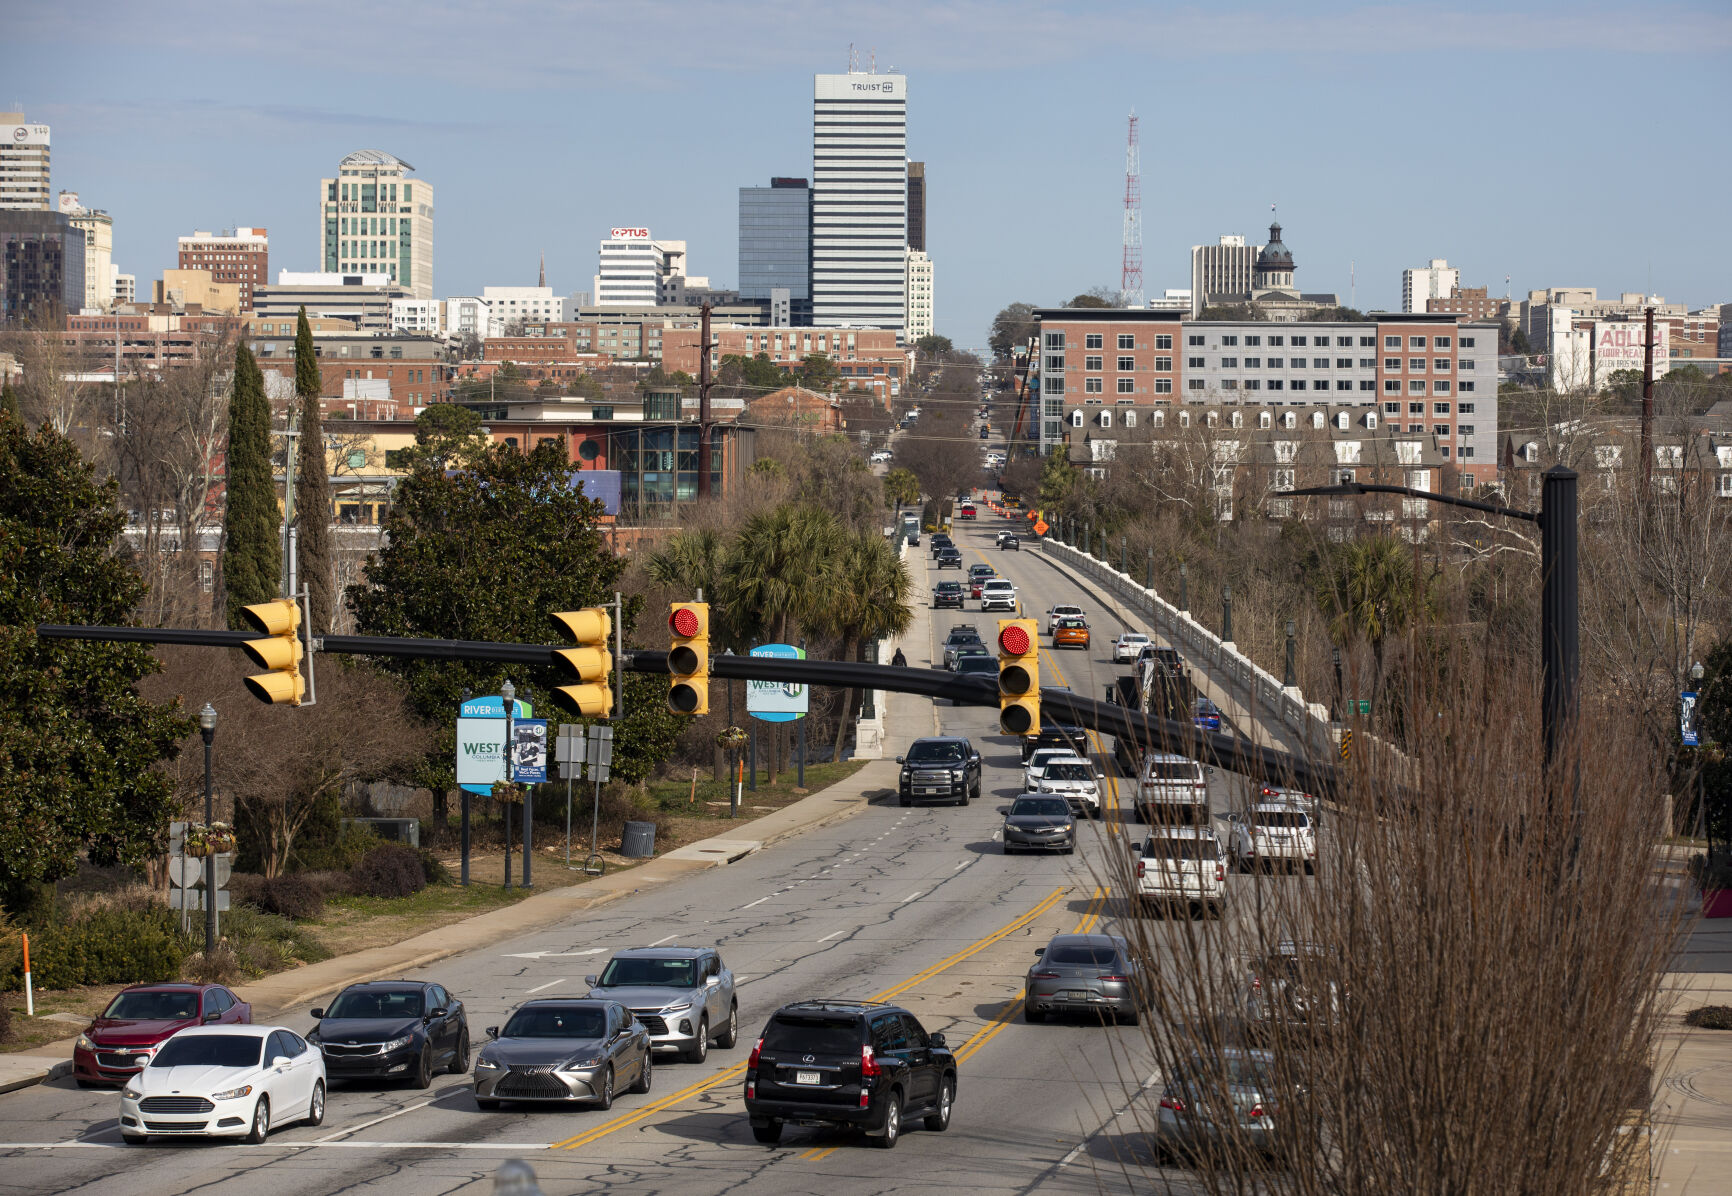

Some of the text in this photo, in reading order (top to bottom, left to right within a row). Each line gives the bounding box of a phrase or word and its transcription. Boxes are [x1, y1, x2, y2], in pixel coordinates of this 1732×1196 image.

[851, 83, 881, 91] TRUIST
[464, 705, 492, 715] RIVER
[463, 742, 501, 755] WEST
